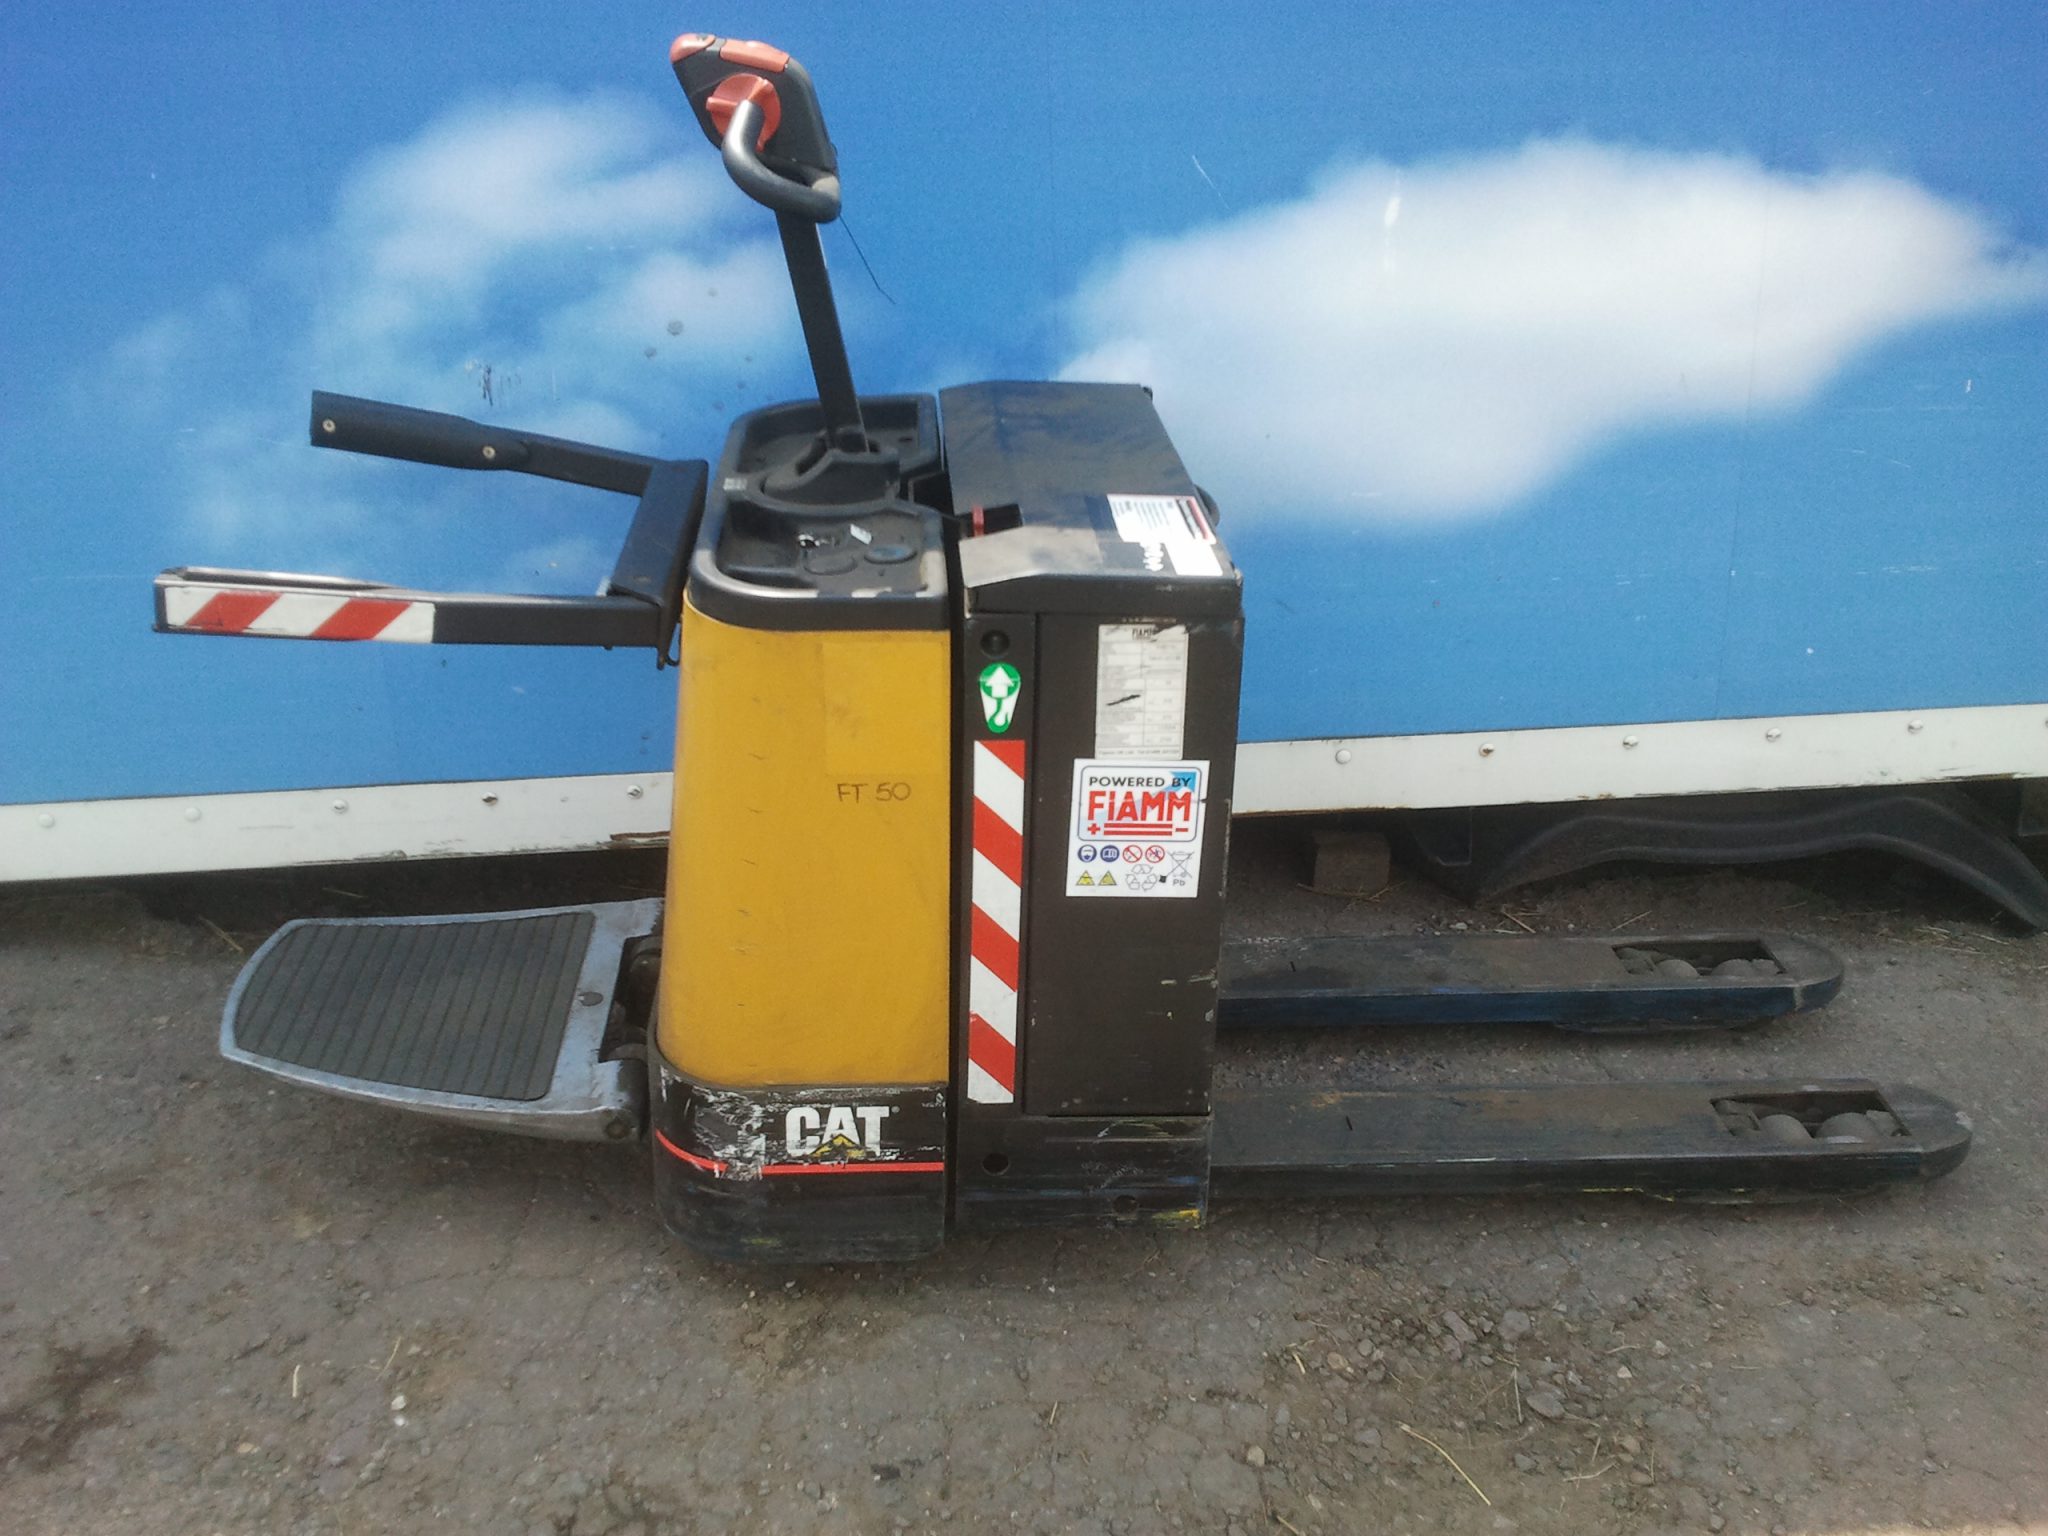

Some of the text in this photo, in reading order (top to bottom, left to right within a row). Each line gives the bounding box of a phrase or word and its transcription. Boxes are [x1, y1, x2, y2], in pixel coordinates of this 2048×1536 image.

[837, 781, 912, 804] FT 50
[1089, 776, 1191, 787] POWERED BY
[1087, 790, 1192, 822] FIAMM
[1172, 878, 1186, 887] Pb
[785, 1105, 890, 1158] CAT
